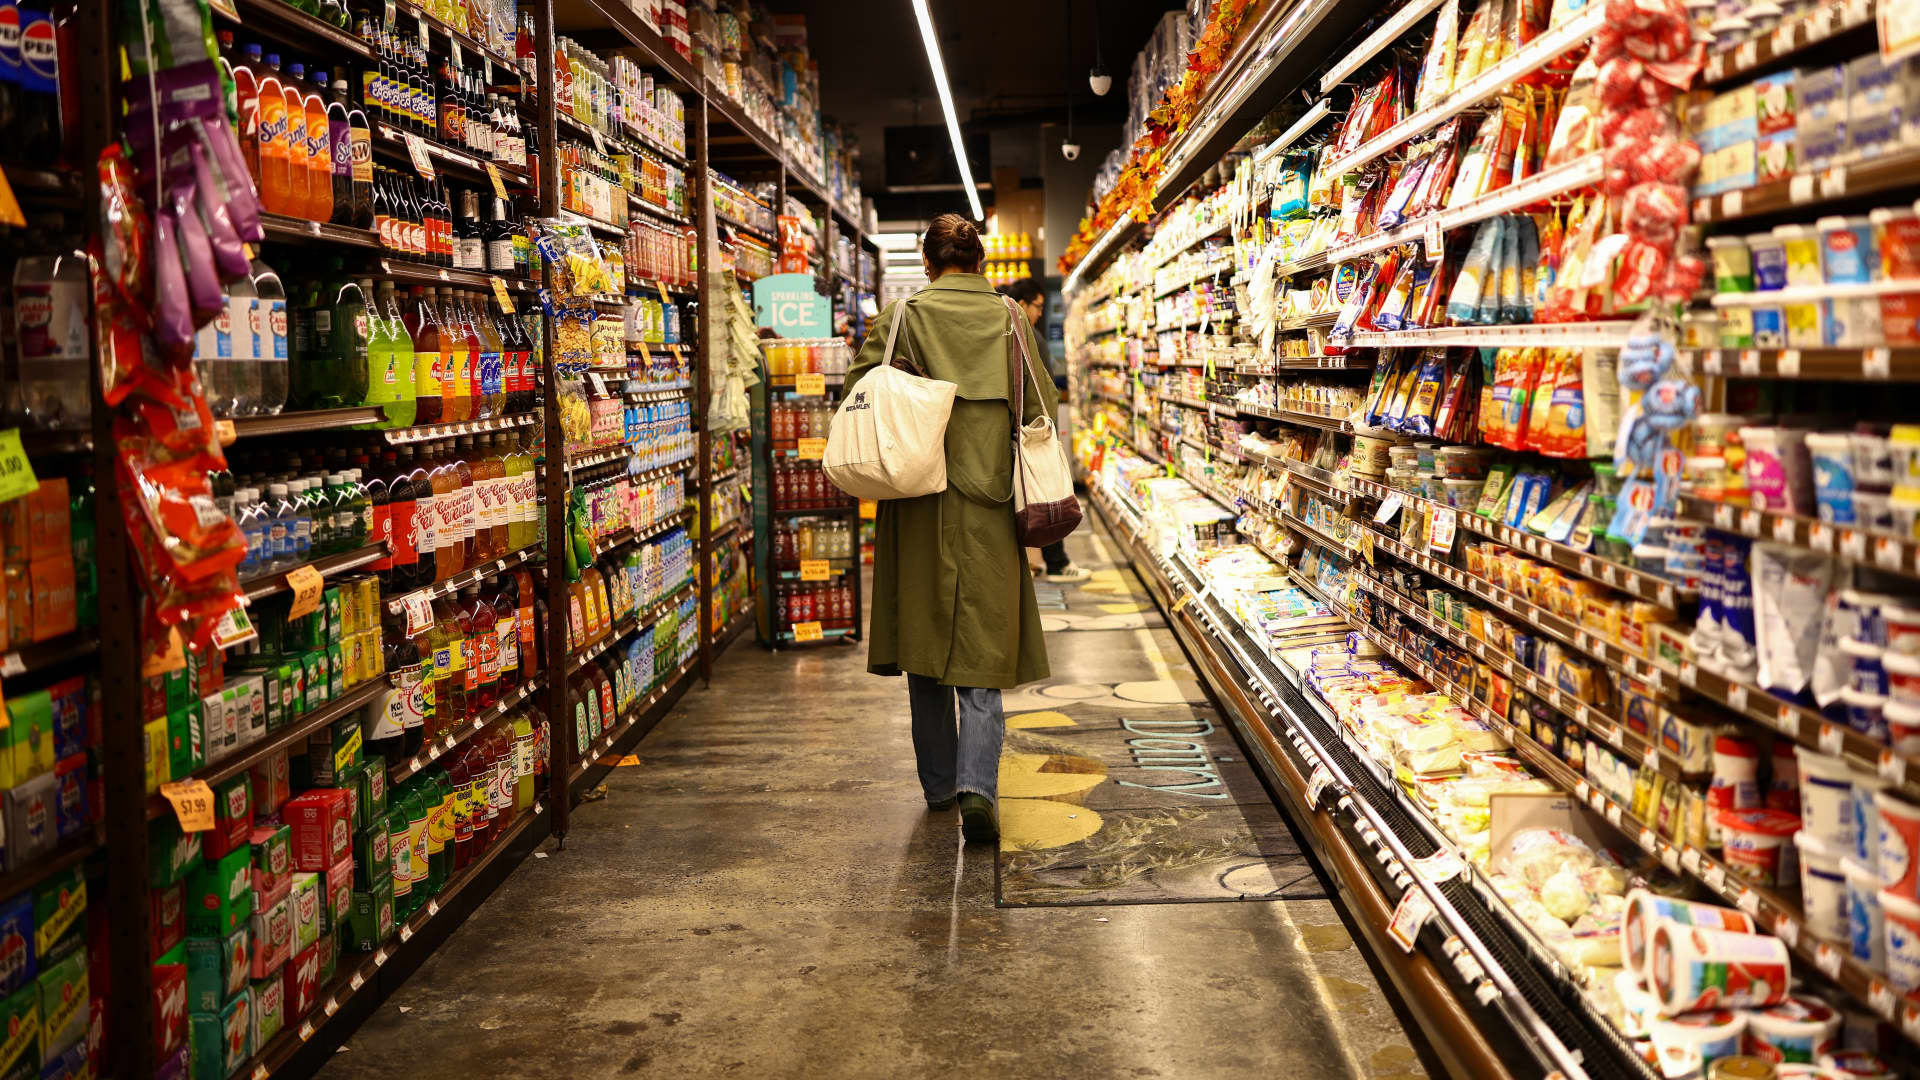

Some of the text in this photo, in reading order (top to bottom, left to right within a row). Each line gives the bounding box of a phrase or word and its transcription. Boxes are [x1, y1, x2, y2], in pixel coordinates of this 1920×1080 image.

[771, 291, 814, 301] SPARKLING
[772, 302, 818, 326] ICE
[846, 403, 870, 412] STANLEY
[1119, 717, 1233, 799] Dairy
